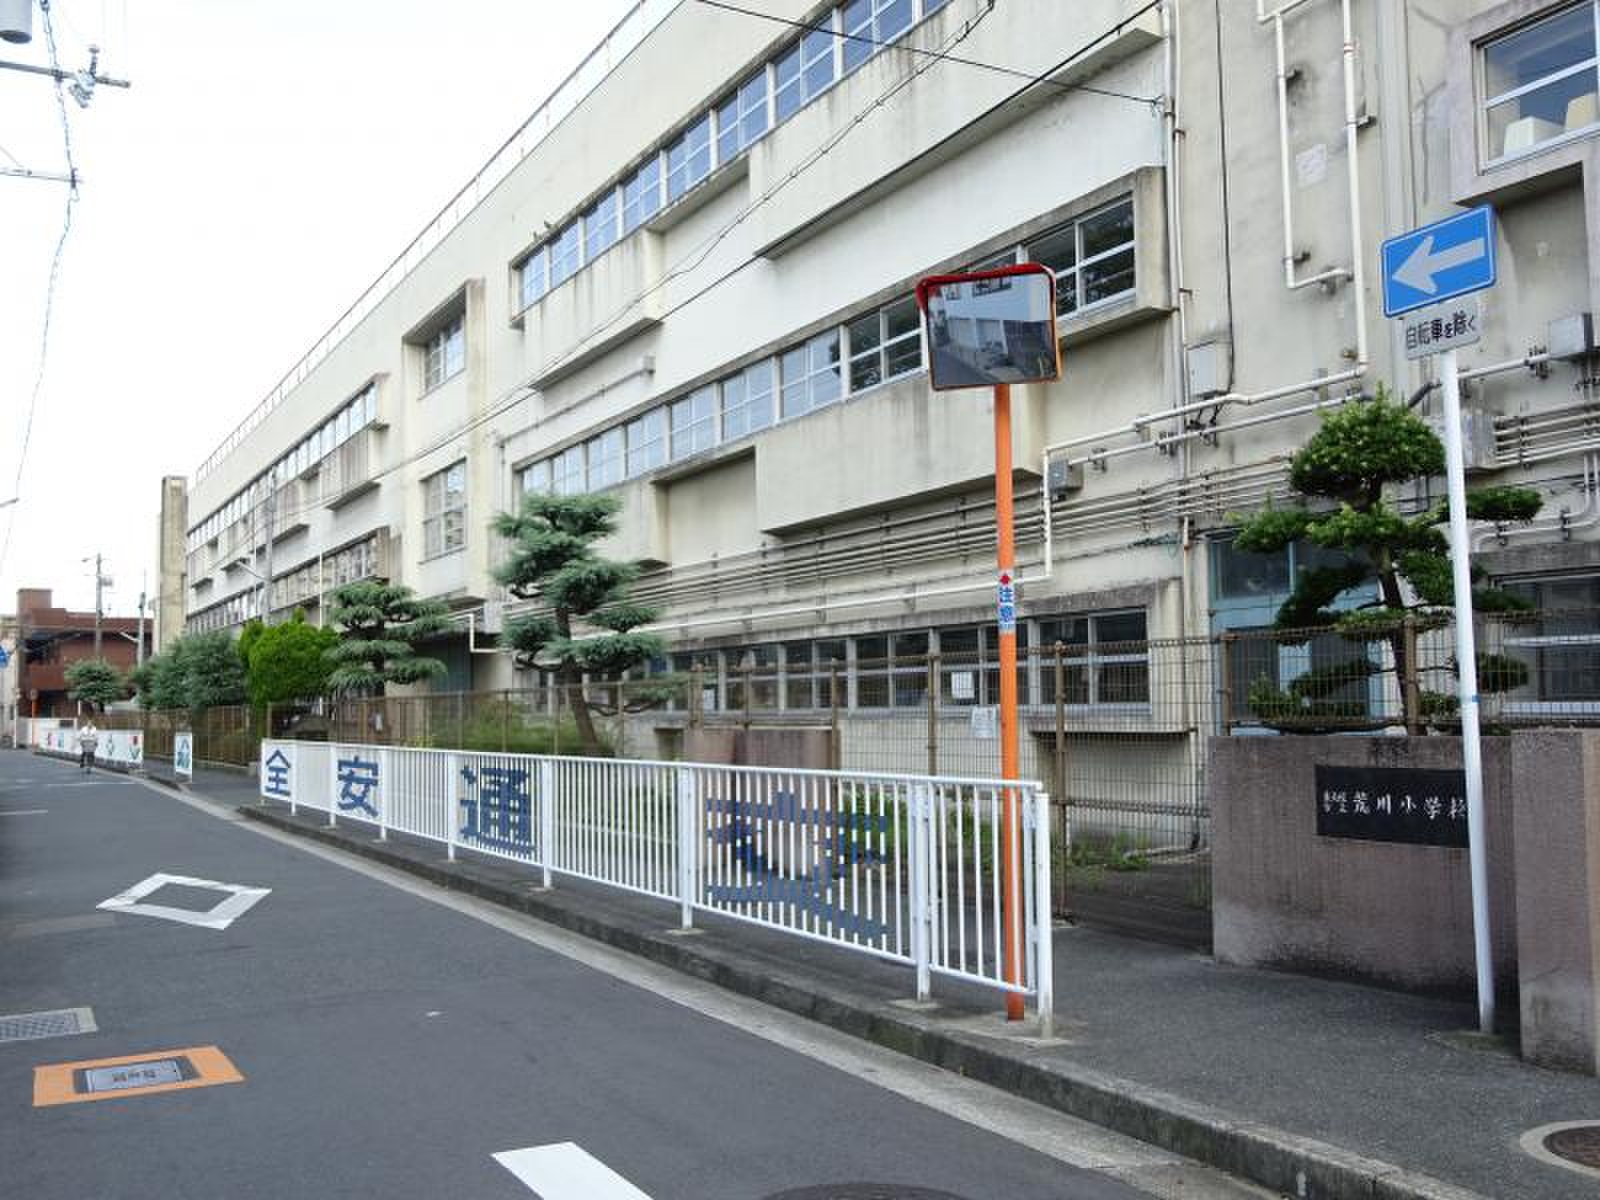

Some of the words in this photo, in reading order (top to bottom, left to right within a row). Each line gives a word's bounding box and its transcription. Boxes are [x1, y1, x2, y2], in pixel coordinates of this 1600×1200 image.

[1406, 310, 1477, 350] 自転車を除く
